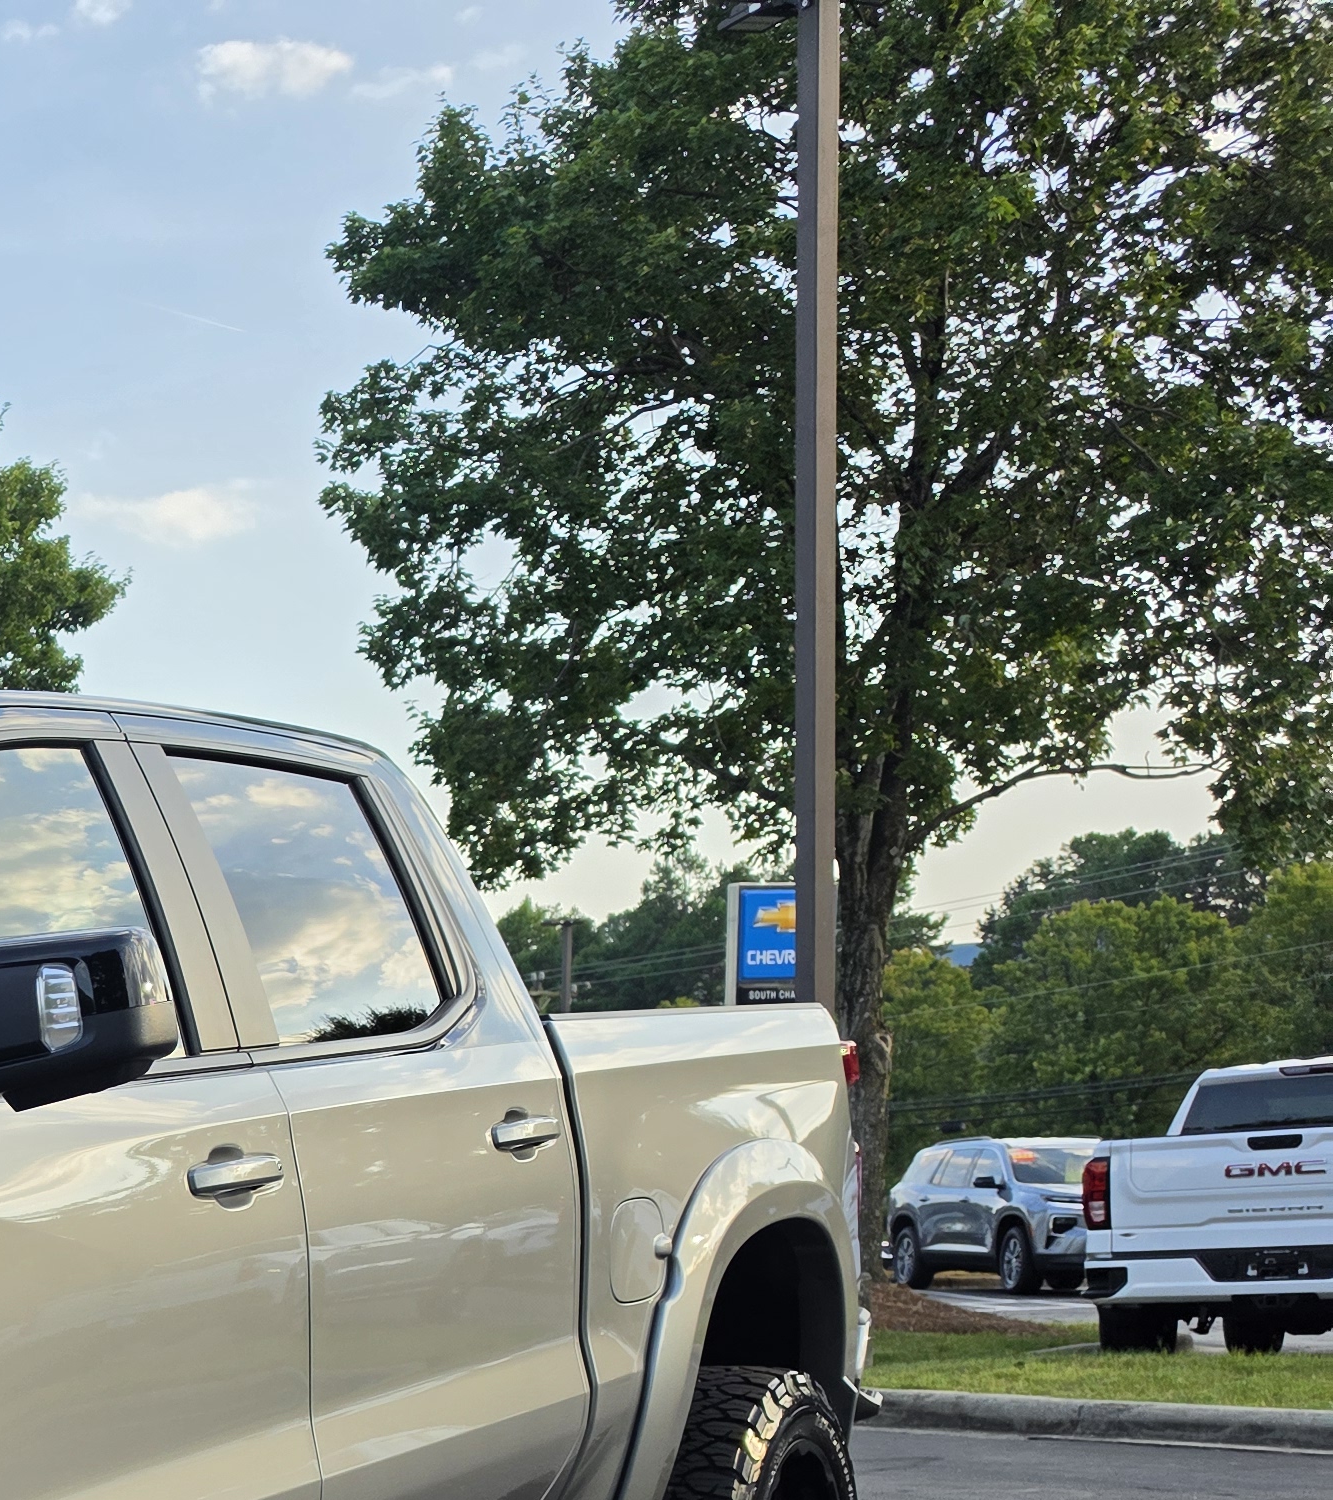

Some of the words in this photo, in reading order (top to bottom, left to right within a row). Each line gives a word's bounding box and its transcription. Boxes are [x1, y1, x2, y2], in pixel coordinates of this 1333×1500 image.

[746, 949, 796, 966] CHEVR
[748, 989, 777, 1000] SOUTH
[778, 989, 796, 1000] CHA
[1224, 1159, 1329, 1179] GMC
